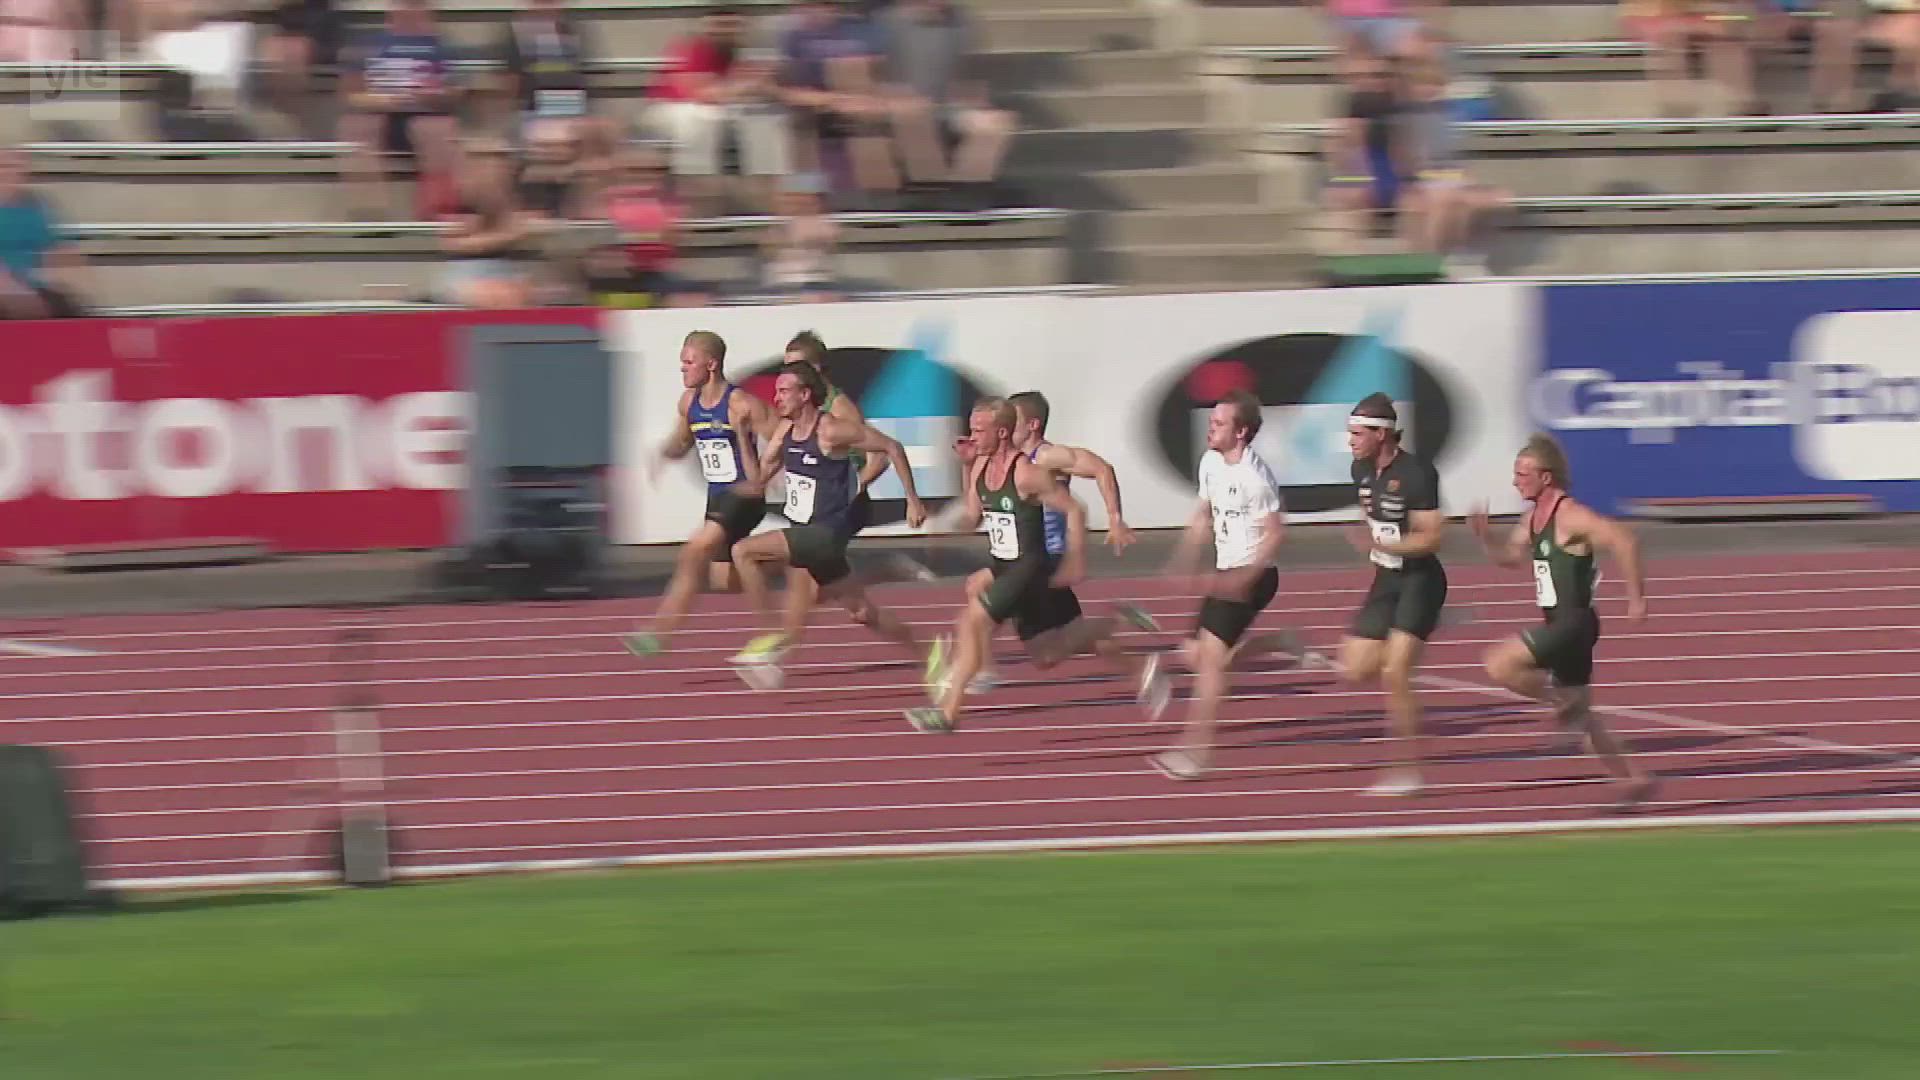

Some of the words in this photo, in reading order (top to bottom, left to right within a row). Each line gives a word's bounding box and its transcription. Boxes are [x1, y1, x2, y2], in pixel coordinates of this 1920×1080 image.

[0, 368, 474, 501] tone
[703, 453, 721, 469] 18
[790, 489, 799, 507] 6
[991, 527, 1005, 545] 12
